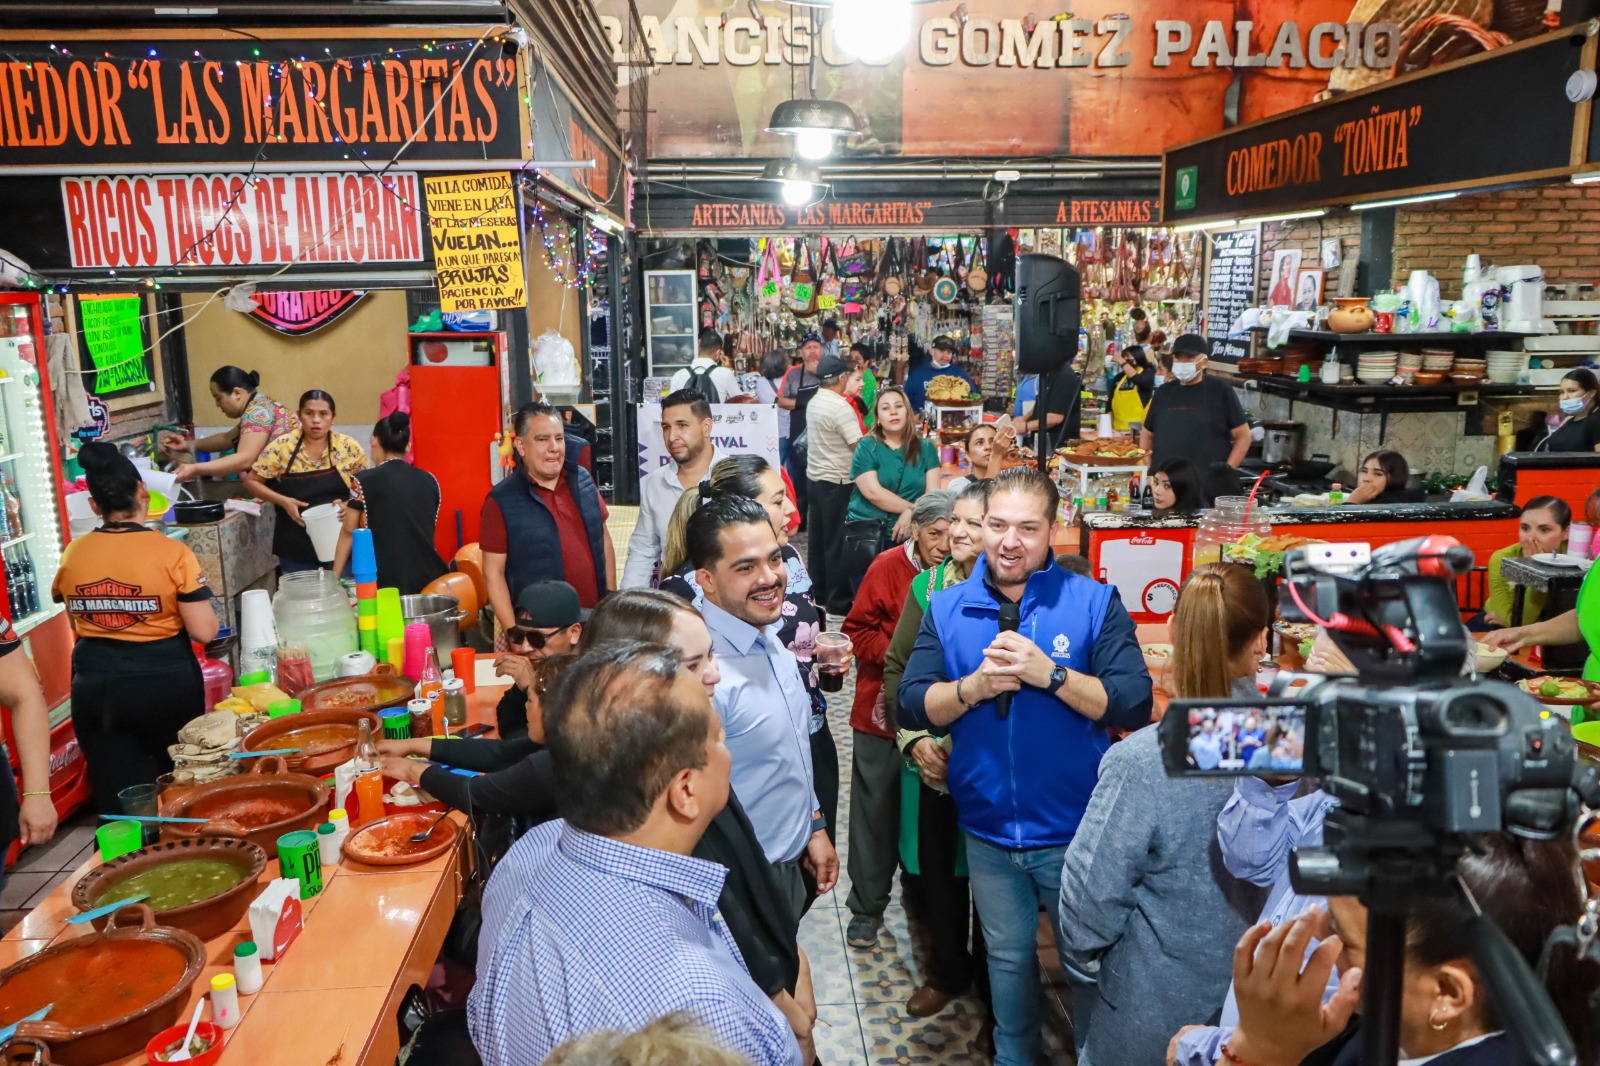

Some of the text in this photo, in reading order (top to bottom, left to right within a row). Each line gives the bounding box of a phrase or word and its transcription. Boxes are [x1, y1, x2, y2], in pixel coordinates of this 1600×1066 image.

[919, 17, 1135, 68] GOMEZ
[1152, 19, 1401, 69] PALACIO
[1226, 105, 1422, 196] COMEDOR “TOÑITA”
[426, 175, 512, 195] NI LA COMIDA
[428, 195, 515, 212] VIENE EN LATA
[66, 175, 421, 267] RICOS TACOS DE ALACRAN
[446, 218, 468, 228] LAS
[469, 216, 518, 228] MESERAS
[692, 203, 786, 226] ARTESANIAS
[461, 253, 481, 266] QUE
[438, 264, 510, 289] BRUJAS
[441, 286, 504, 299] PACIENCIA
[455, 288, 523, 310] POR FAVOR!!
[1130, 536, 1154, 545] Coca-Cola
[84, 584, 133, 596] COMEDOR
[1146, 592, 1154, 602] $
[69, 599, 158, 612] LAS MARGARITAS
